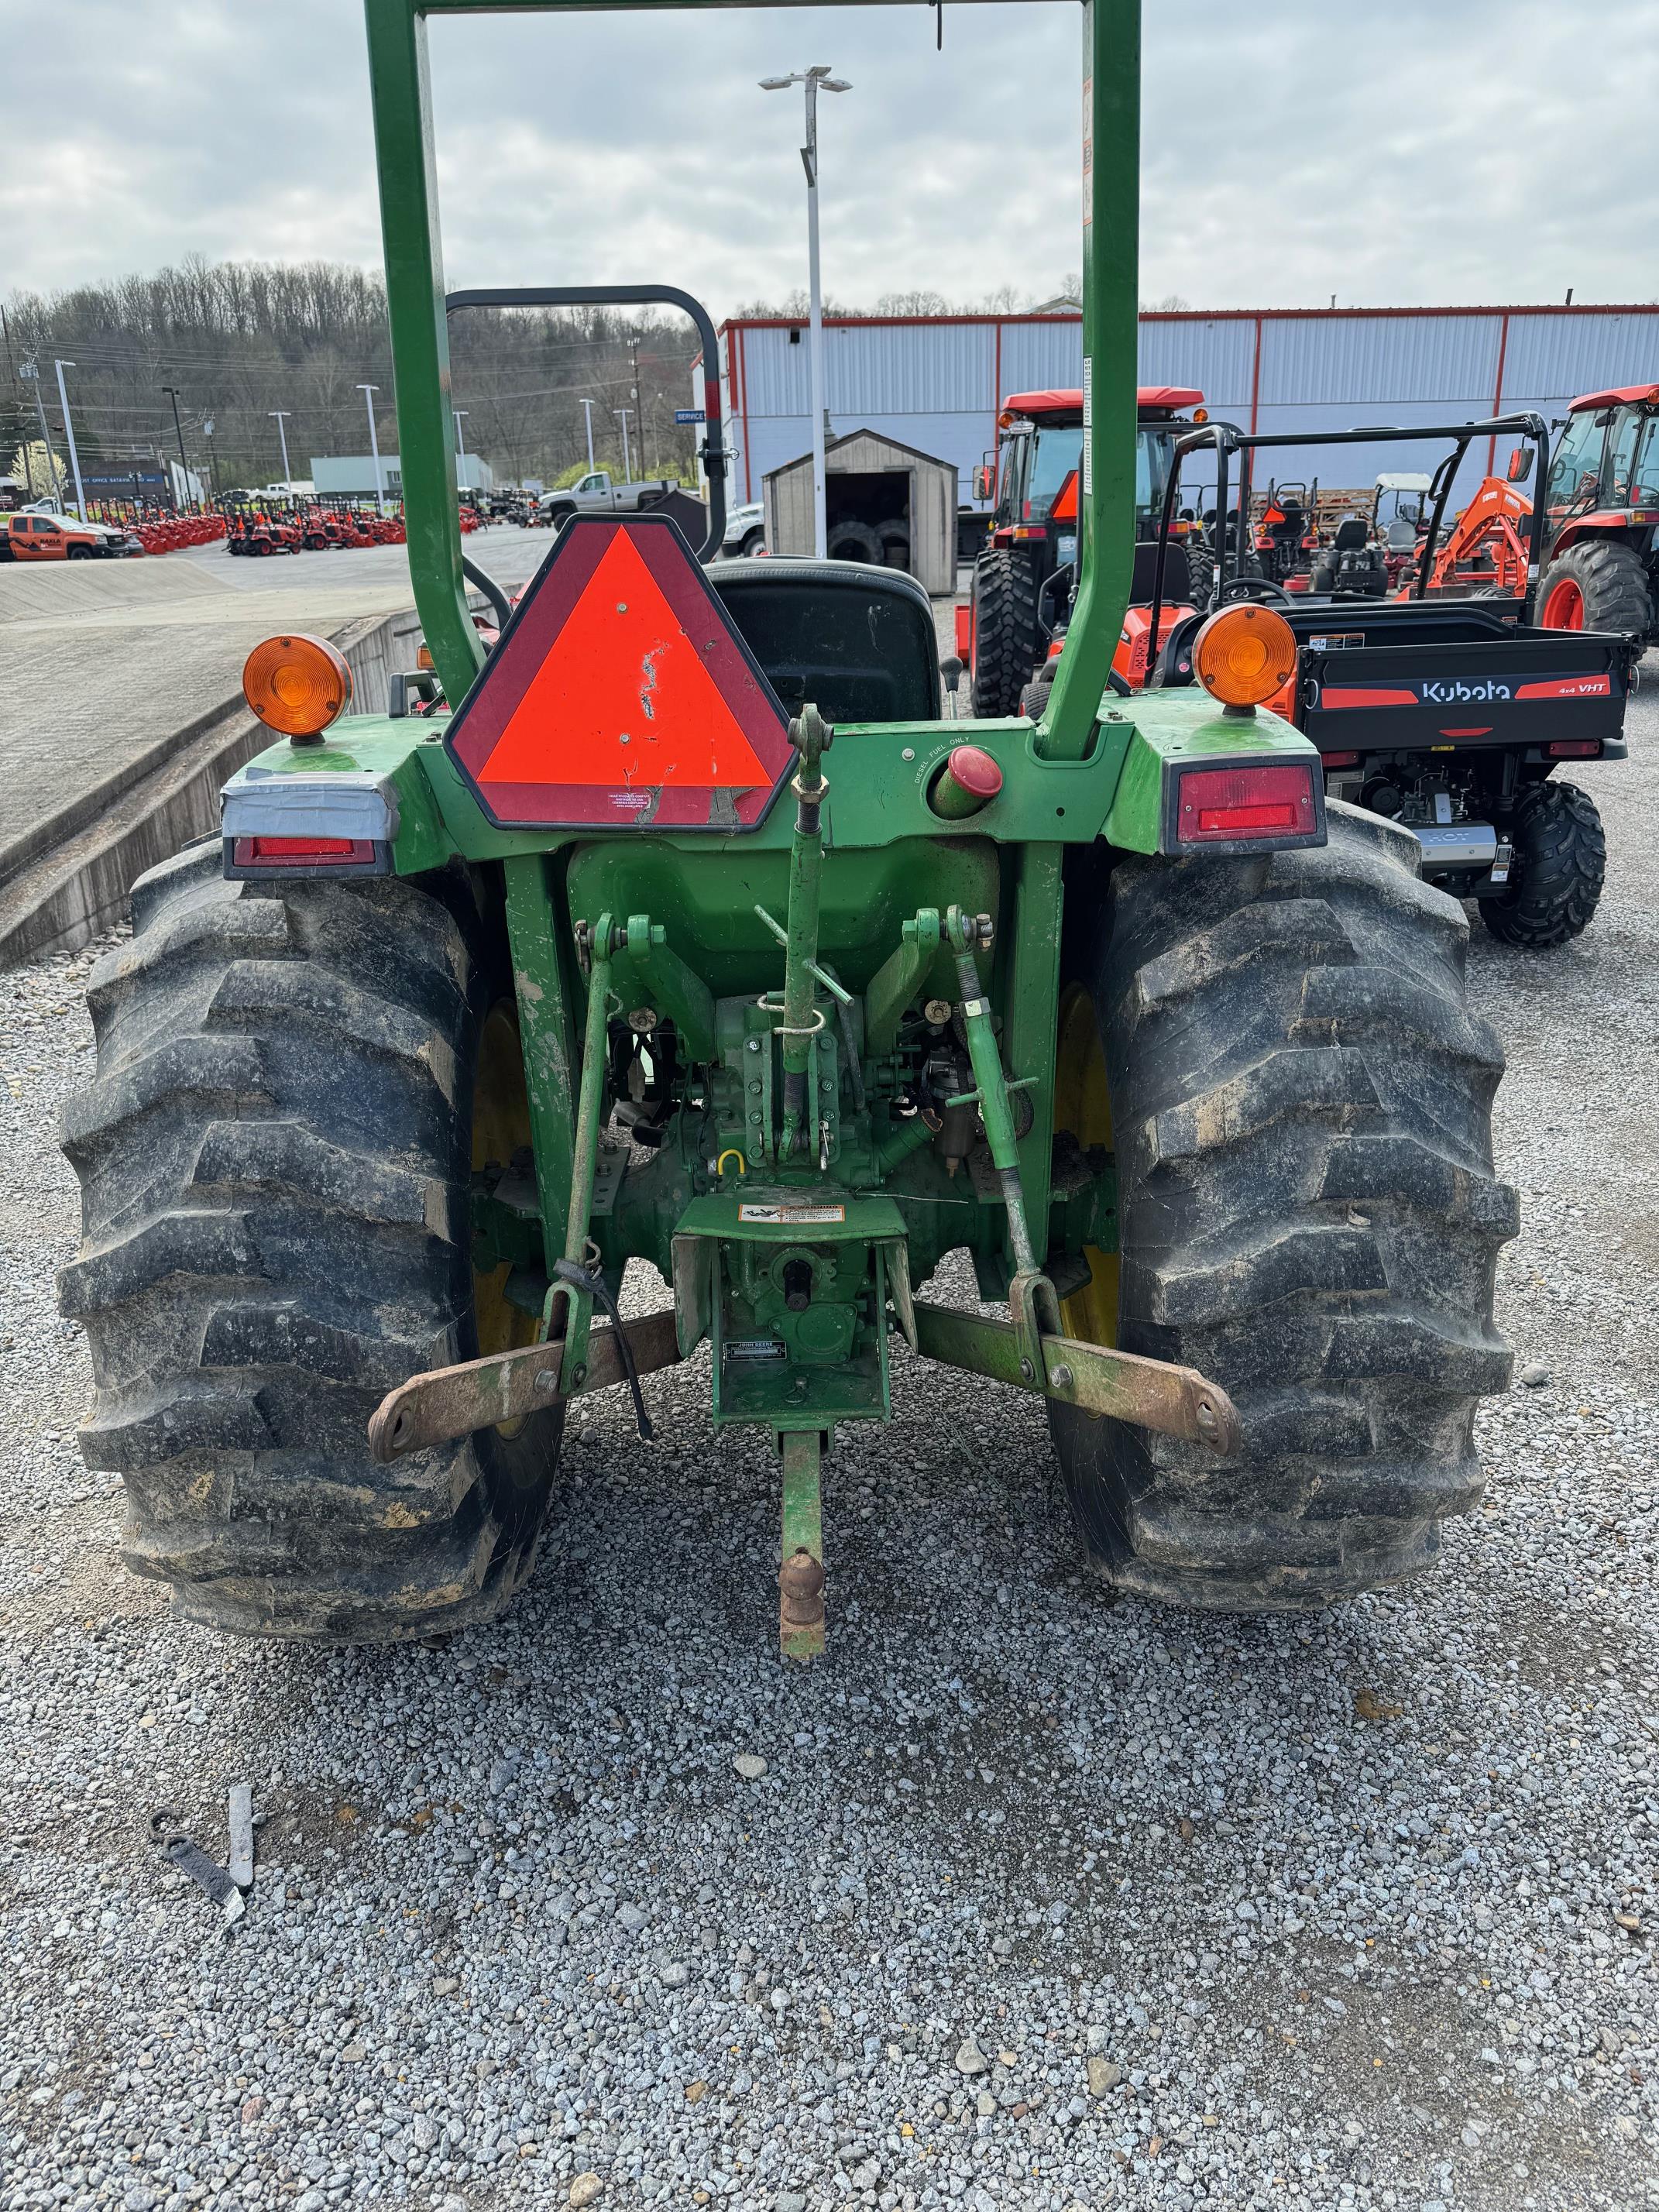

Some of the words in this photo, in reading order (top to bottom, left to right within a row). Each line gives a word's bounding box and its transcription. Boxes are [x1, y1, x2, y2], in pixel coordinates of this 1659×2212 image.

[1423, 680, 1510, 702] Kubota
[1578, 683, 1607, 692] VHT
[914, 760, 929, 784] DIESEL
[929, 744, 946, 758] FUEL
[950, 736, 970, 746] ONLY
[1428, 832, 1469, 842] HOT
